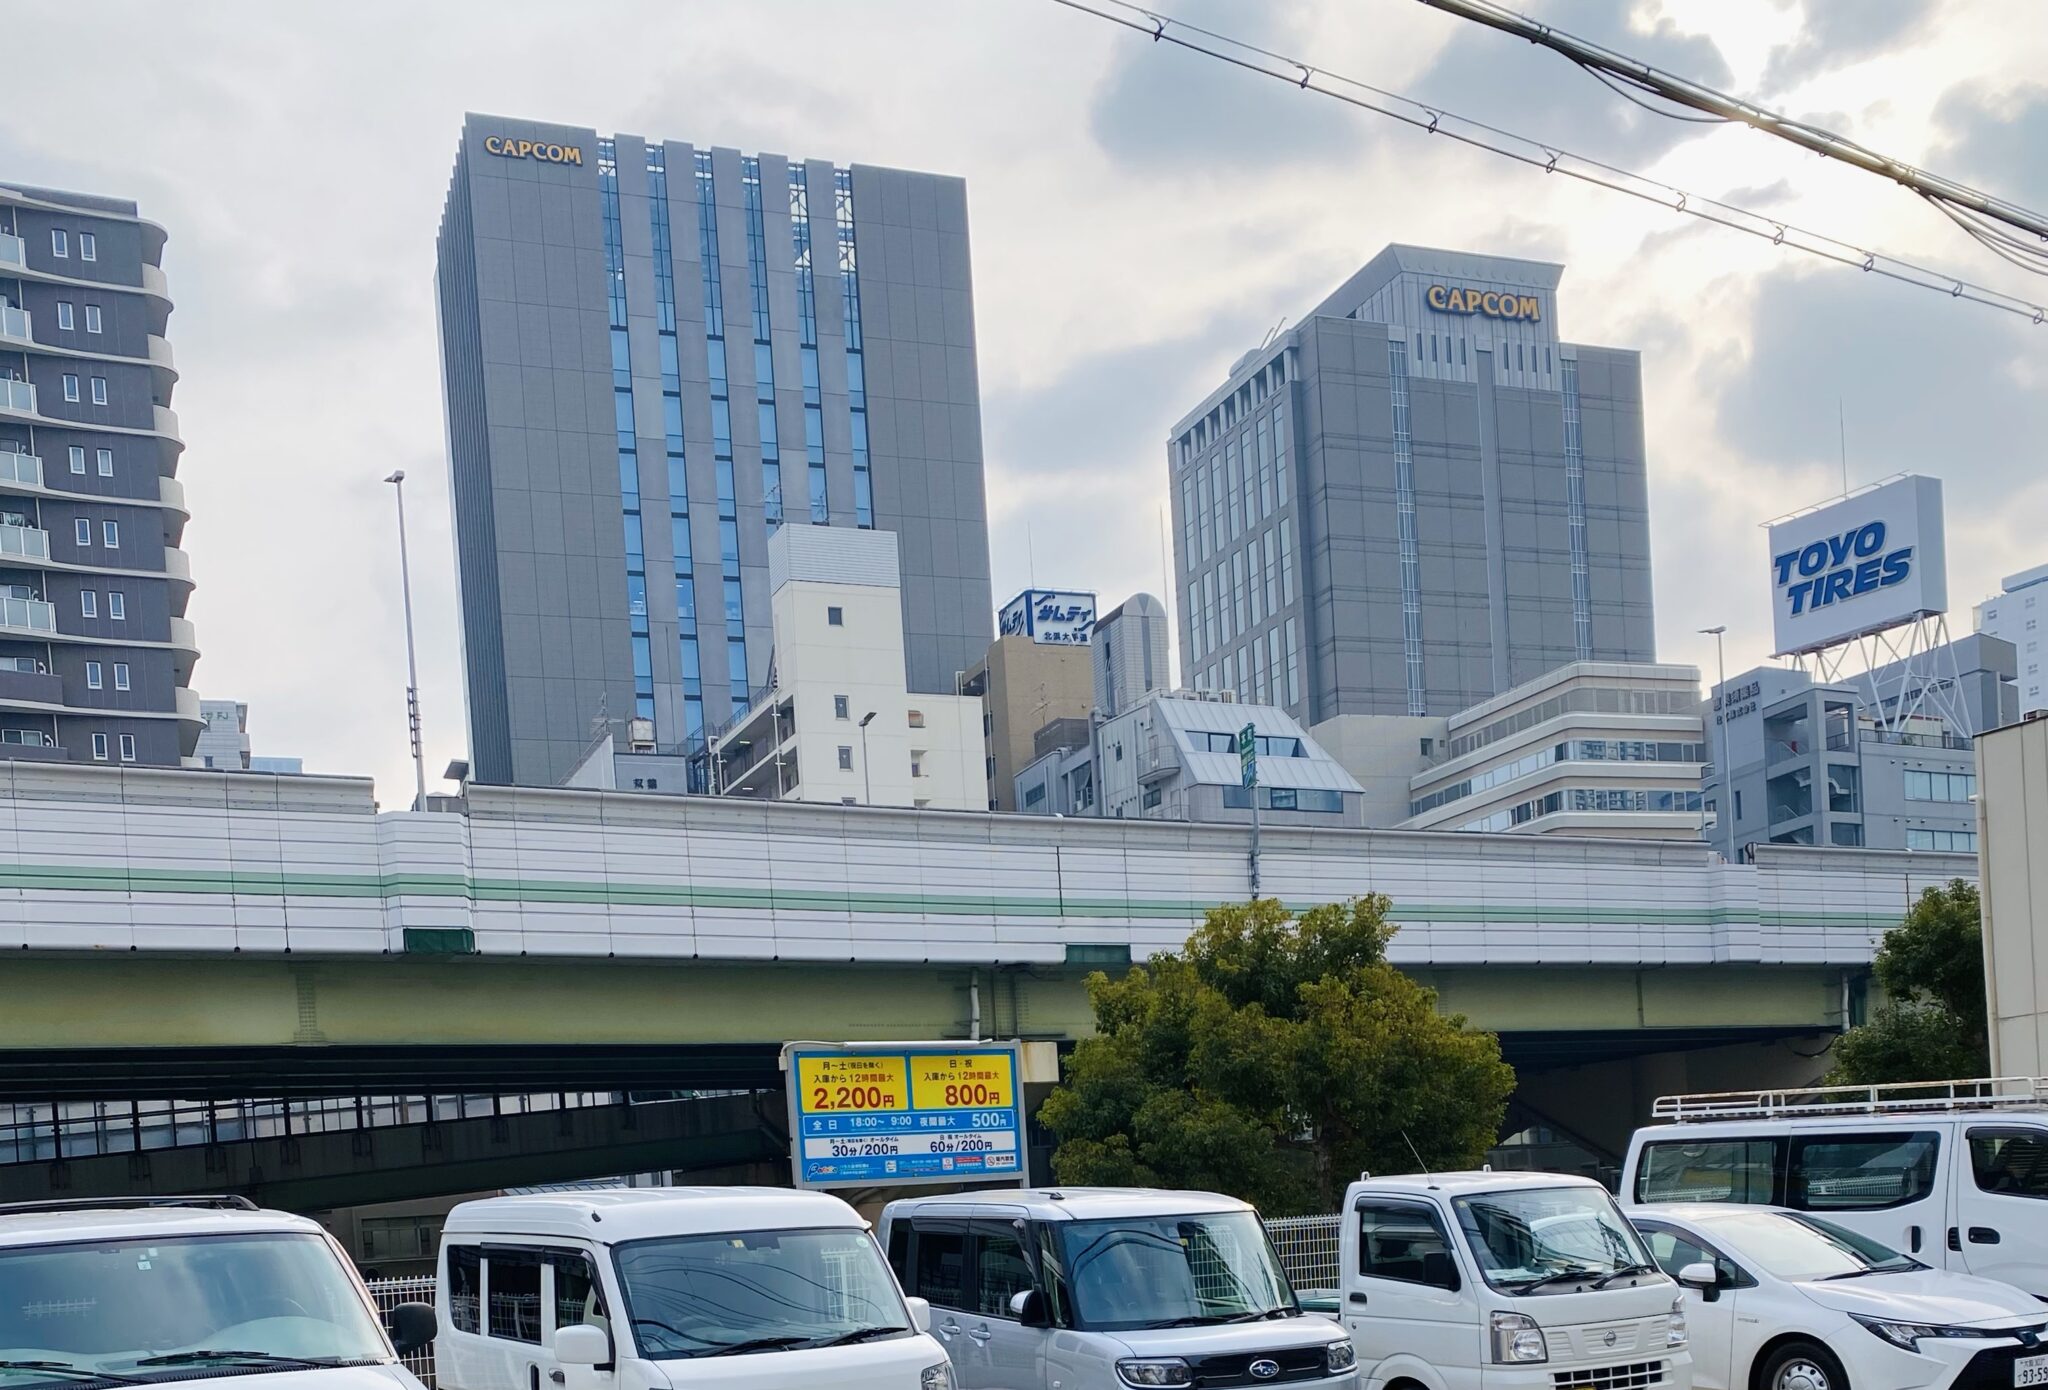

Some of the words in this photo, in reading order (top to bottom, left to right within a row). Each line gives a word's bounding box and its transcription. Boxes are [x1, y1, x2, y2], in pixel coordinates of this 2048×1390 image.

[485, 136, 582, 166] CAPCOM
[1426, 285, 1540, 322] CAPCOM
[1774, 520, 1886, 587] TOYO
[1787, 547, 1912, 616] TIRES
[1037, 604, 1092, 621] サムティ
[813, 1086, 895, 1110] 2,200円
[945, 1084, 1000, 1106] 800円
[972, 1112, 1007, 1127] 500円
[832, 1143, 899, 1157] 30分/200円
[930, 1140, 993, 1153] 60分/200円
